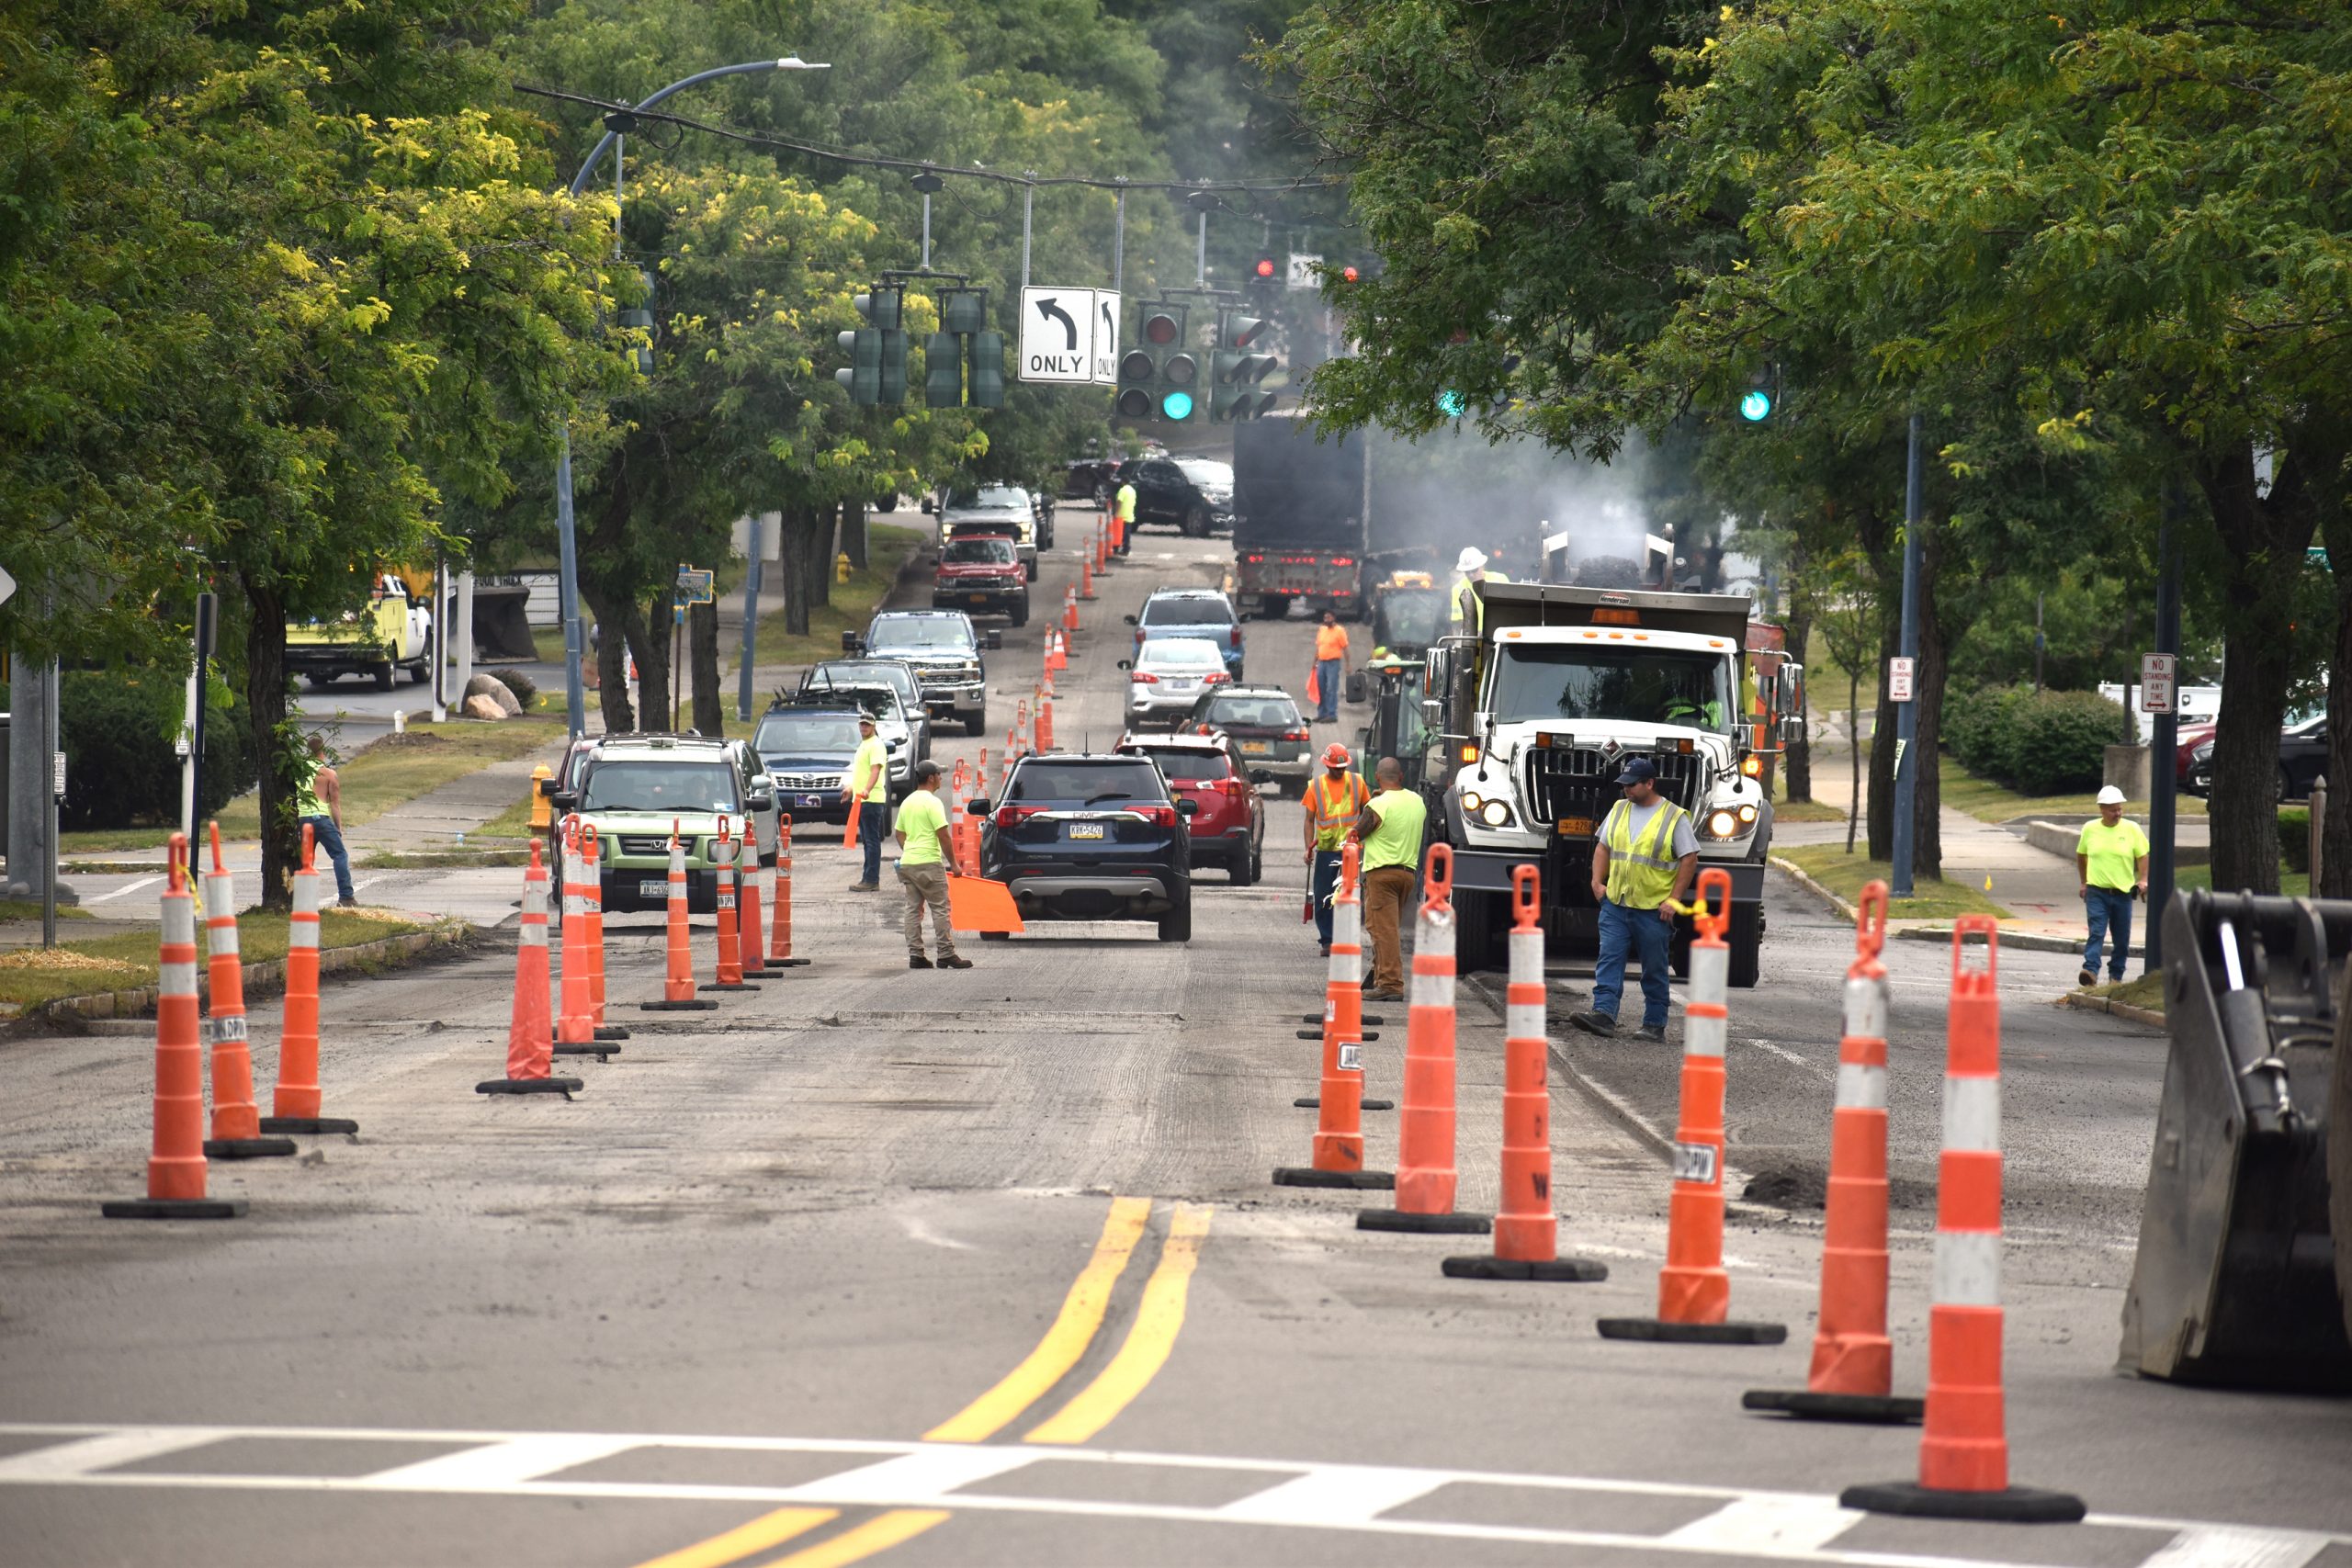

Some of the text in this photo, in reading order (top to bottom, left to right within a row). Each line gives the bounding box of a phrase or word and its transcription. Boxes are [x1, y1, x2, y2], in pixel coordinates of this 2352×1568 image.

[1031, 355, 1082, 373] ONLY
[1098, 358, 1115, 376] ONLY
[1600, 596, 1630, 604] Henderson
[1897, 661, 1906, 671] NO
[2152, 660, 2164, 671] NO
[2143, 672, 2172, 682] STANDING
[2151, 682, 2164, 691] ANY
[2150, 692, 2164, 701] TIME
[1073, 811, 1101, 819] GMC
